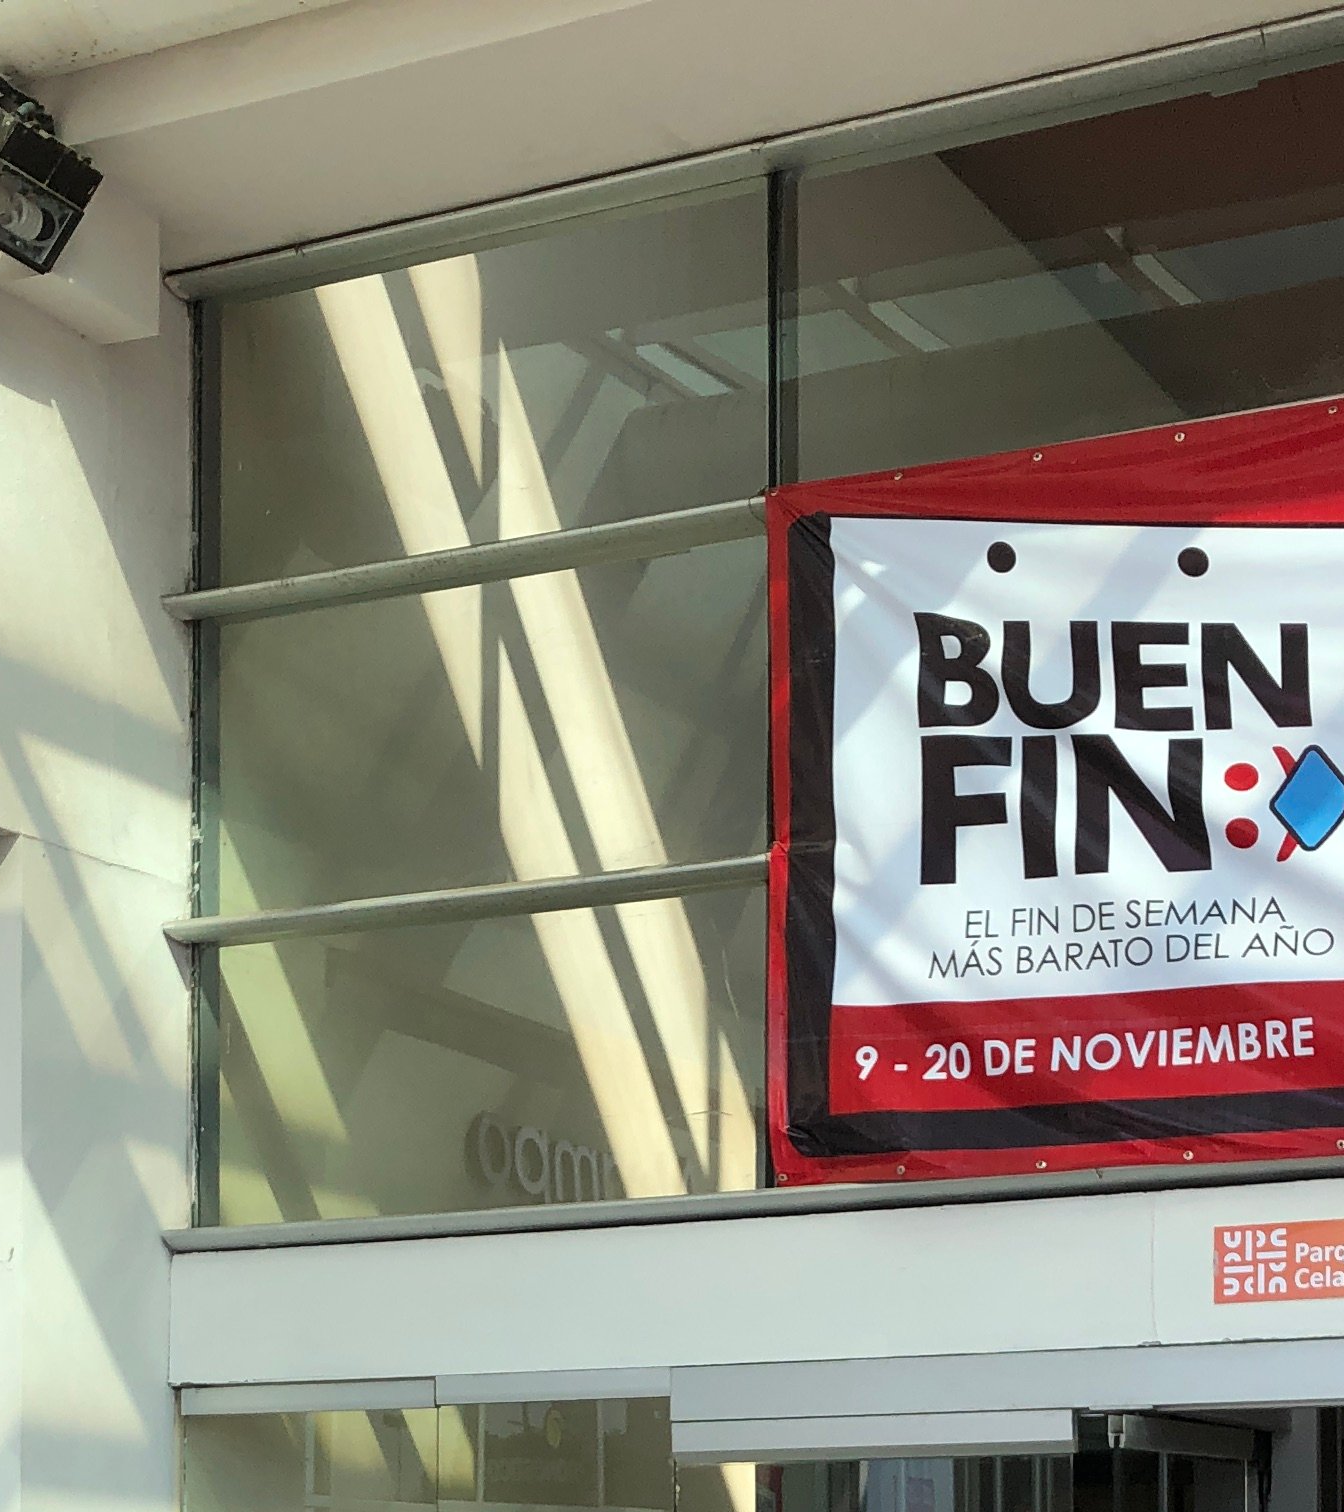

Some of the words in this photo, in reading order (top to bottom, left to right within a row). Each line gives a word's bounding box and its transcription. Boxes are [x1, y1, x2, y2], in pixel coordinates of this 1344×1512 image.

[914, 612, 1312, 731] BUEN
[965, 910, 998, 938] EL
[1012, 906, 1059, 936] FIN
[1074, 903, 1115, 932] DE
[1125, 897, 1286, 929] SEMANA
[929, 940, 1002, 978] MÁS
[1017, 941, 1152, 973] BARATO
[1166, 934, 1229, 960] DEL
[1241, 924, 1334, 957] AÑO
[856, 1046, 878, 1080] 9
[923, 1042, 970, 1079] 20
[984, 1039, 1036, 1076] DE
[1051, 1017, 1314, 1070] NOVIEMBRE
